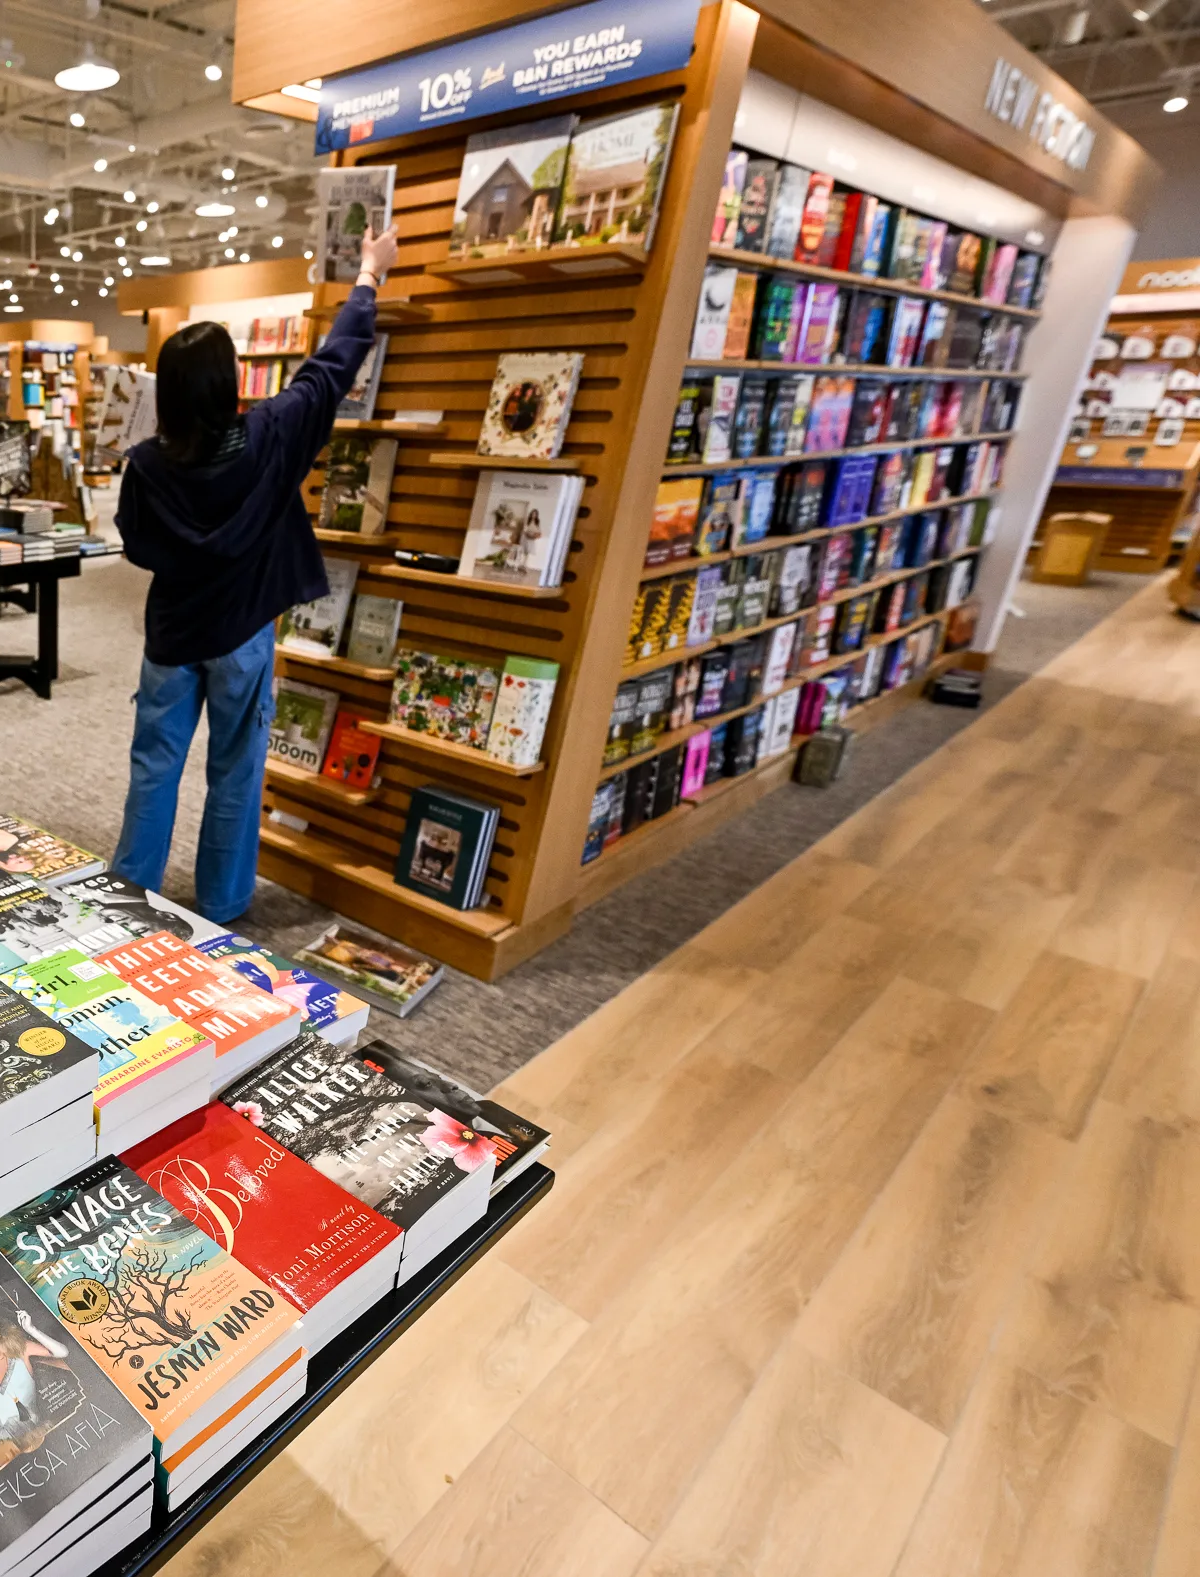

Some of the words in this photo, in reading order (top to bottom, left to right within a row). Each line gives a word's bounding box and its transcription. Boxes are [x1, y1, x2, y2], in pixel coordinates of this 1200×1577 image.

[512, 63, 548, 88] B&N
[551, 39, 644, 78] REWARDS
[532, 39, 570, 65] YOU
[573, 25, 625, 55] EARN
[332, 86, 400, 119] PREMIUM
[418, 67, 472, 113] 10%
[984, 56, 1039, 133] NEW
[1029, 91, 1097, 171] FICTION
[128, 955, 211, 993] EETH
[58, 995, 132, 1028] oman,
[174, 977, 250, 1022] ADIE
[200, 994, 282, 1040] MITH
[95, 1058, 151, 1093] BERNARDINE
[151, 1036, 193, 1060] EVARISTO
[257, 1053, 329, 1107] ALICE
[270, 1063, 370, 1134] WALKER
[336, 1145, 369, 1170] THE
[364, 1104, 417, 1147] TEMPLE
[377, 1145, 401, 1169] OF
[395, 1132, 423, 1155] MY
[55, 1162, 116, 1200] BESTSELLER
[389, 1139, 456, 1195] FAMILIAR
[16, 1175, 142, 1264] SALVAGE
[146, 1137, 286, 1256] Beloved
[37, 1254, 81, 1286] THE
[77, 1202, 173, 1275] BONES
[180, 1235, 205, 1255] NOVEL
[268, 1255, 309, 1289] Toni
[303, 1212, 371, 1260] Morrison
[83, 1303, 108, 1322] WINNER
[86, 1281, 108, 1298] AWARD
[137, 1331, 221, 1411] JESMYN
[212, 1290, 276, 1341] WARD
[70, 1402, 121, 1467] AFIA
